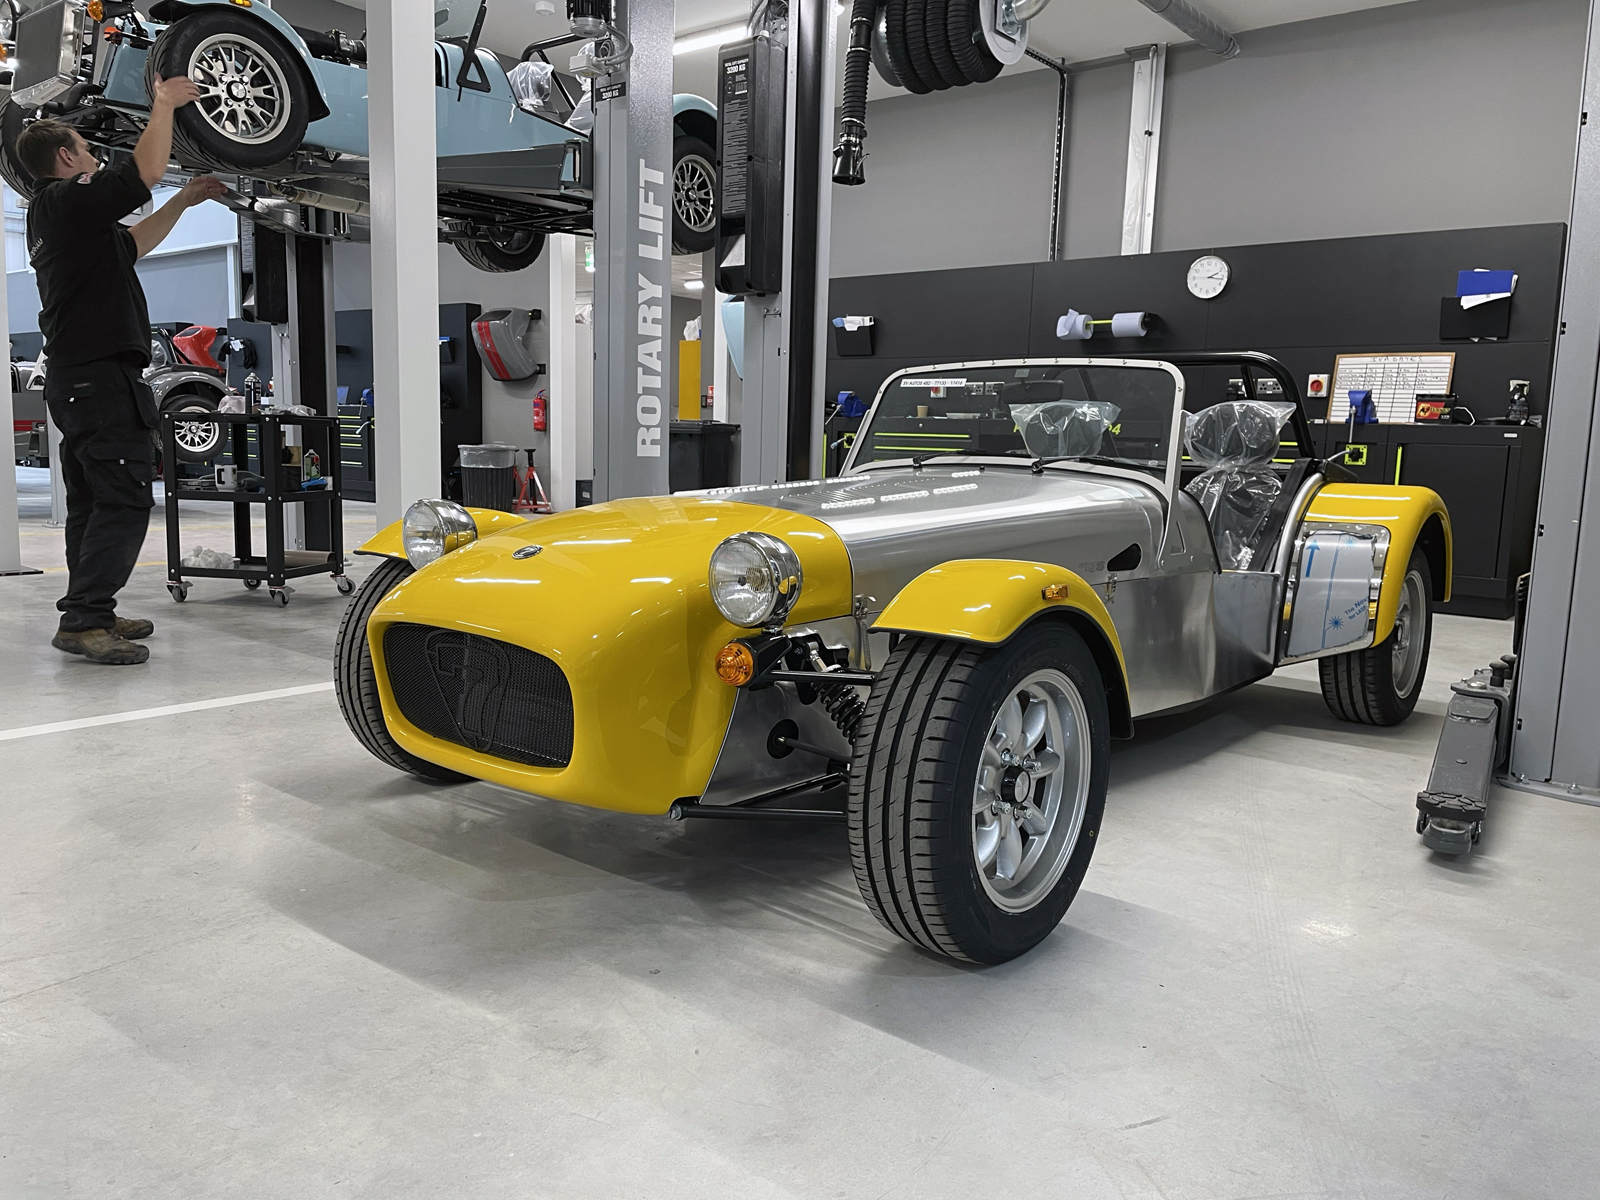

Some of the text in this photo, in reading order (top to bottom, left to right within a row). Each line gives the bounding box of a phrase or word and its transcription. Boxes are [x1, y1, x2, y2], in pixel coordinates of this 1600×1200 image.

[727, 66, 738, 74] 3200
[602, 91, 612, 99] 3200
[636, 158, 664, 457] ROTARY LIFT
